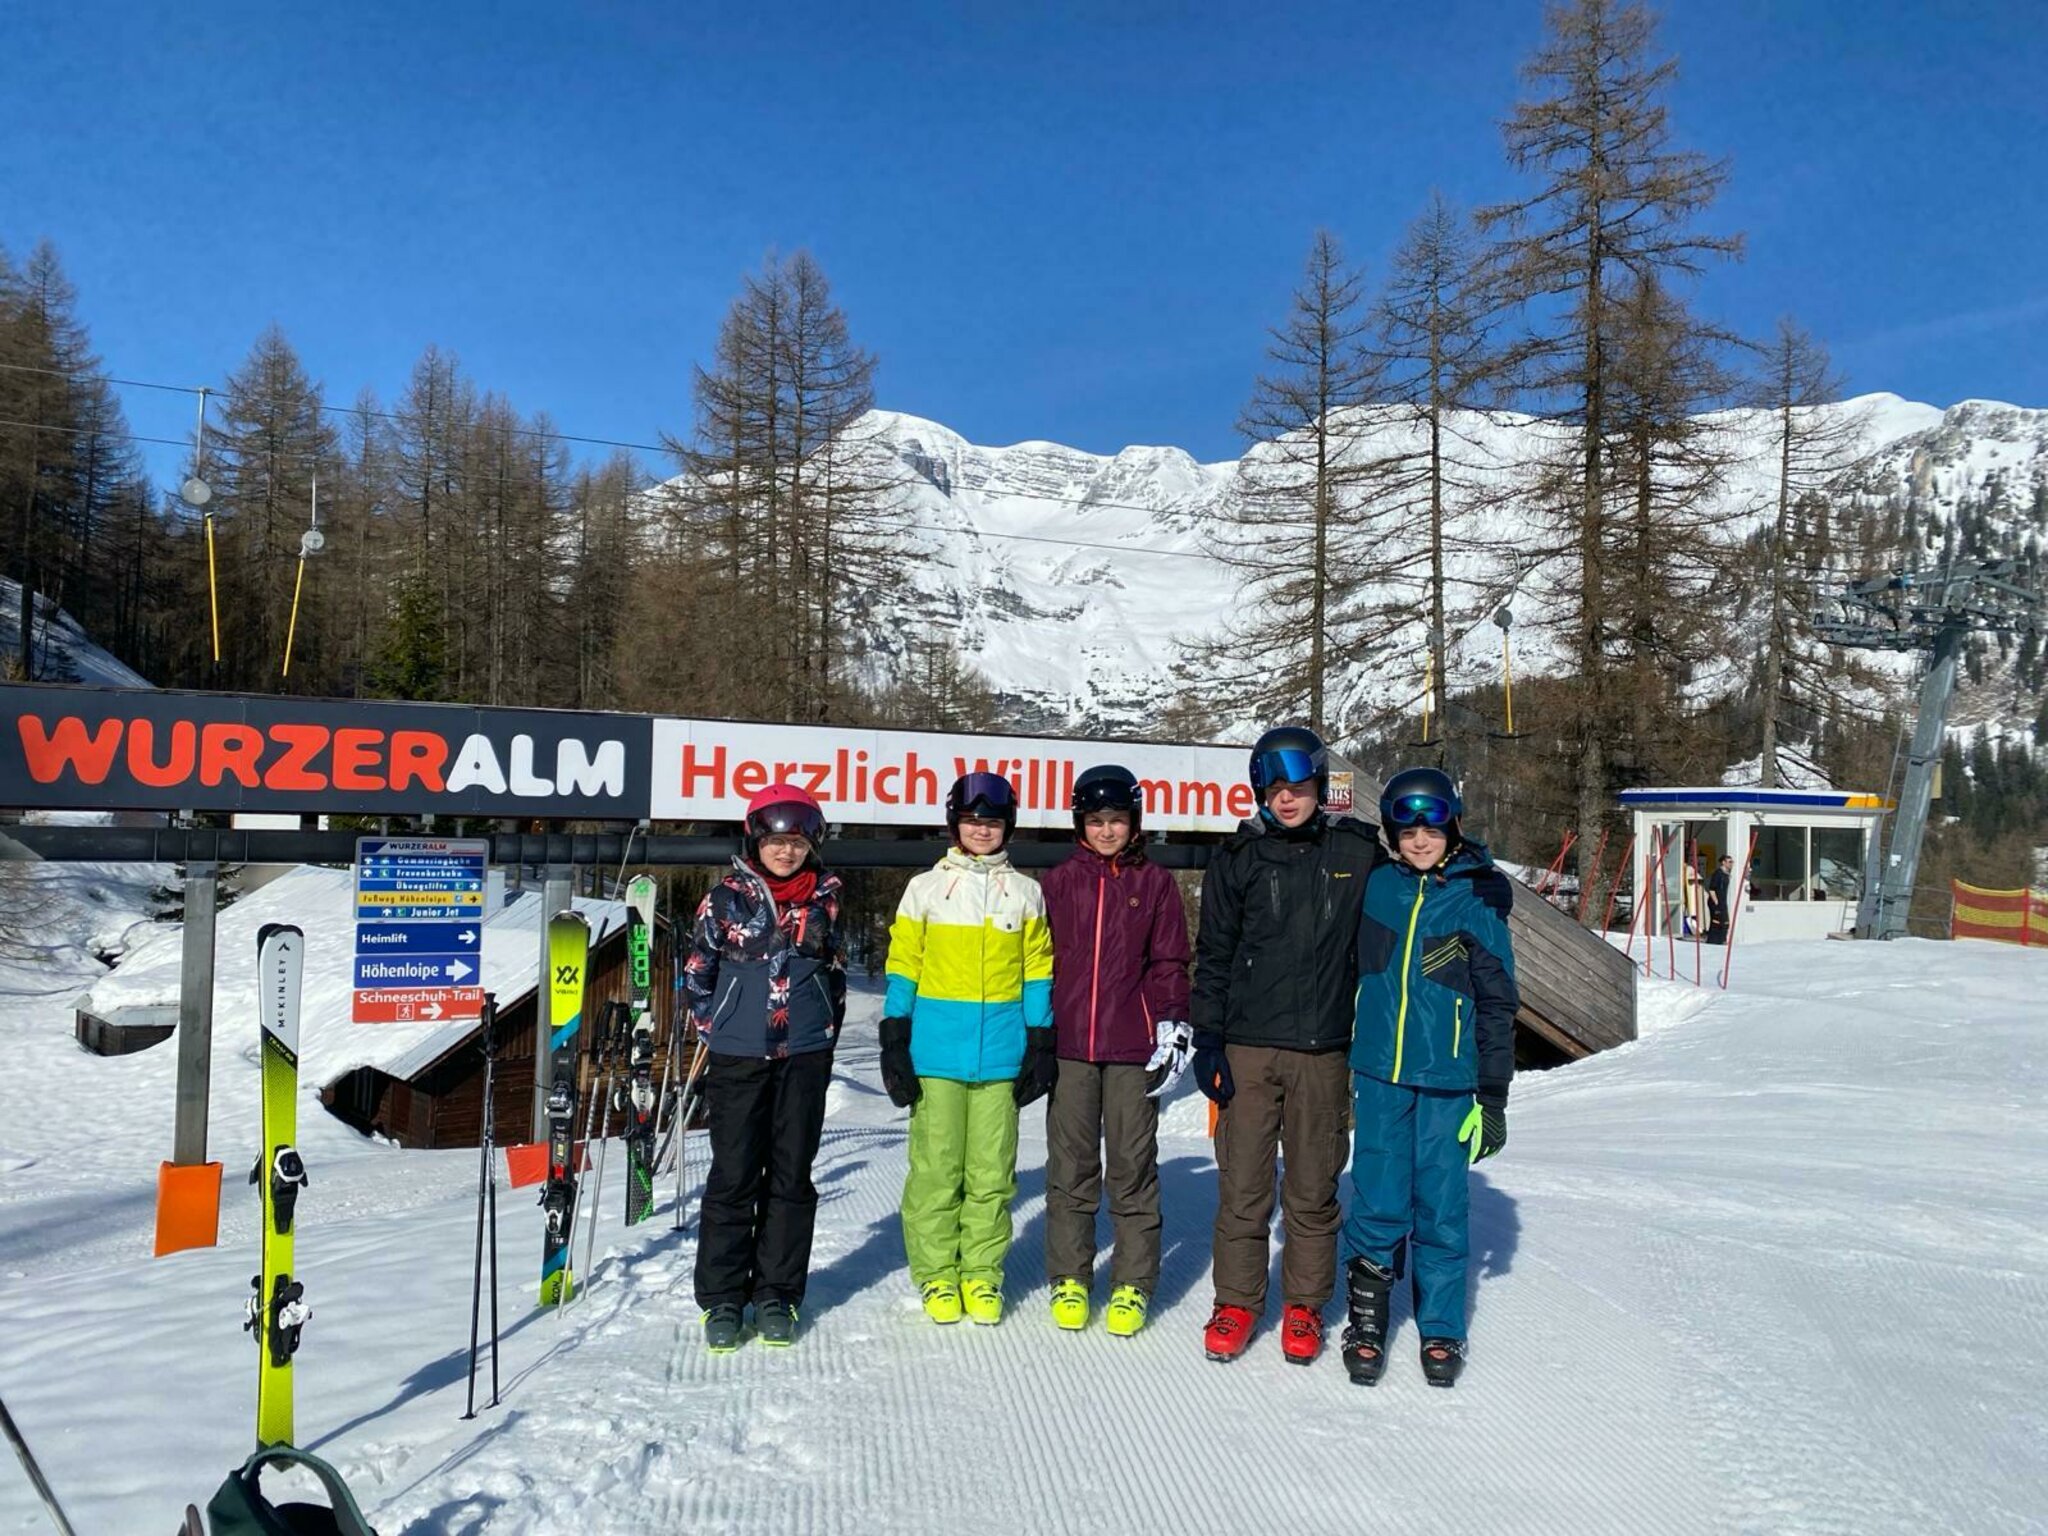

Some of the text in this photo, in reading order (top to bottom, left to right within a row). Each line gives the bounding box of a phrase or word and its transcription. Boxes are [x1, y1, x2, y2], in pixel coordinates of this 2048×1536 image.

[18, 714, 625, 798] WURZERALM
[681, 744, 1254, 818] Herzlich illmme
[389, 843, 447, 851] WURZERALM
[396, 881, 448, 891] Übungslifte
[411, 907, 460, 917] Junior Jet
[361, 933, 408, 944] Heimlift
[361, 962, 440, 980] Höhenloipe
